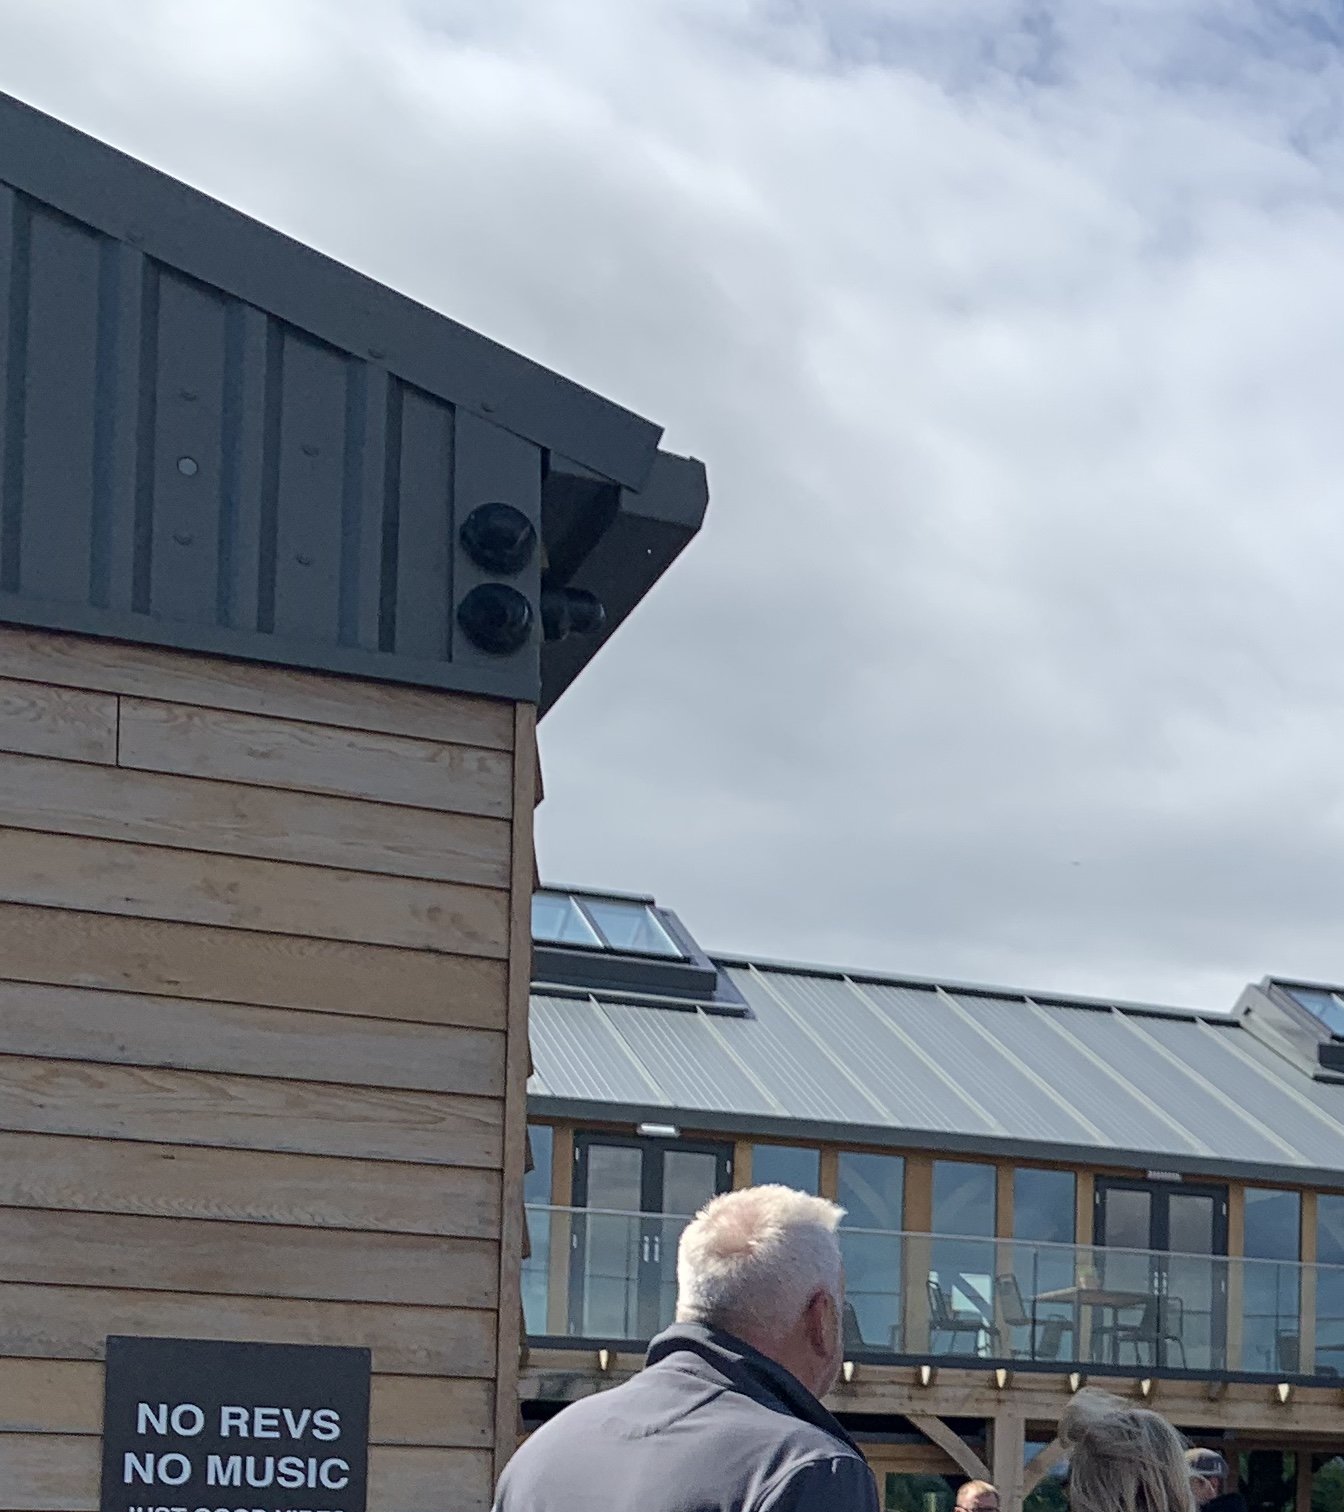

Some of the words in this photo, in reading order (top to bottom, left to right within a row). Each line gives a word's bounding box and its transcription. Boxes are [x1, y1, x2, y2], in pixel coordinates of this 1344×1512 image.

[136, 1402, 205, 1437] NO
[220, 1405, 341, 1441] REVS
[123, 1452, 192, 1486] NO
[206, 1454, 350, 1490] MUSIC
